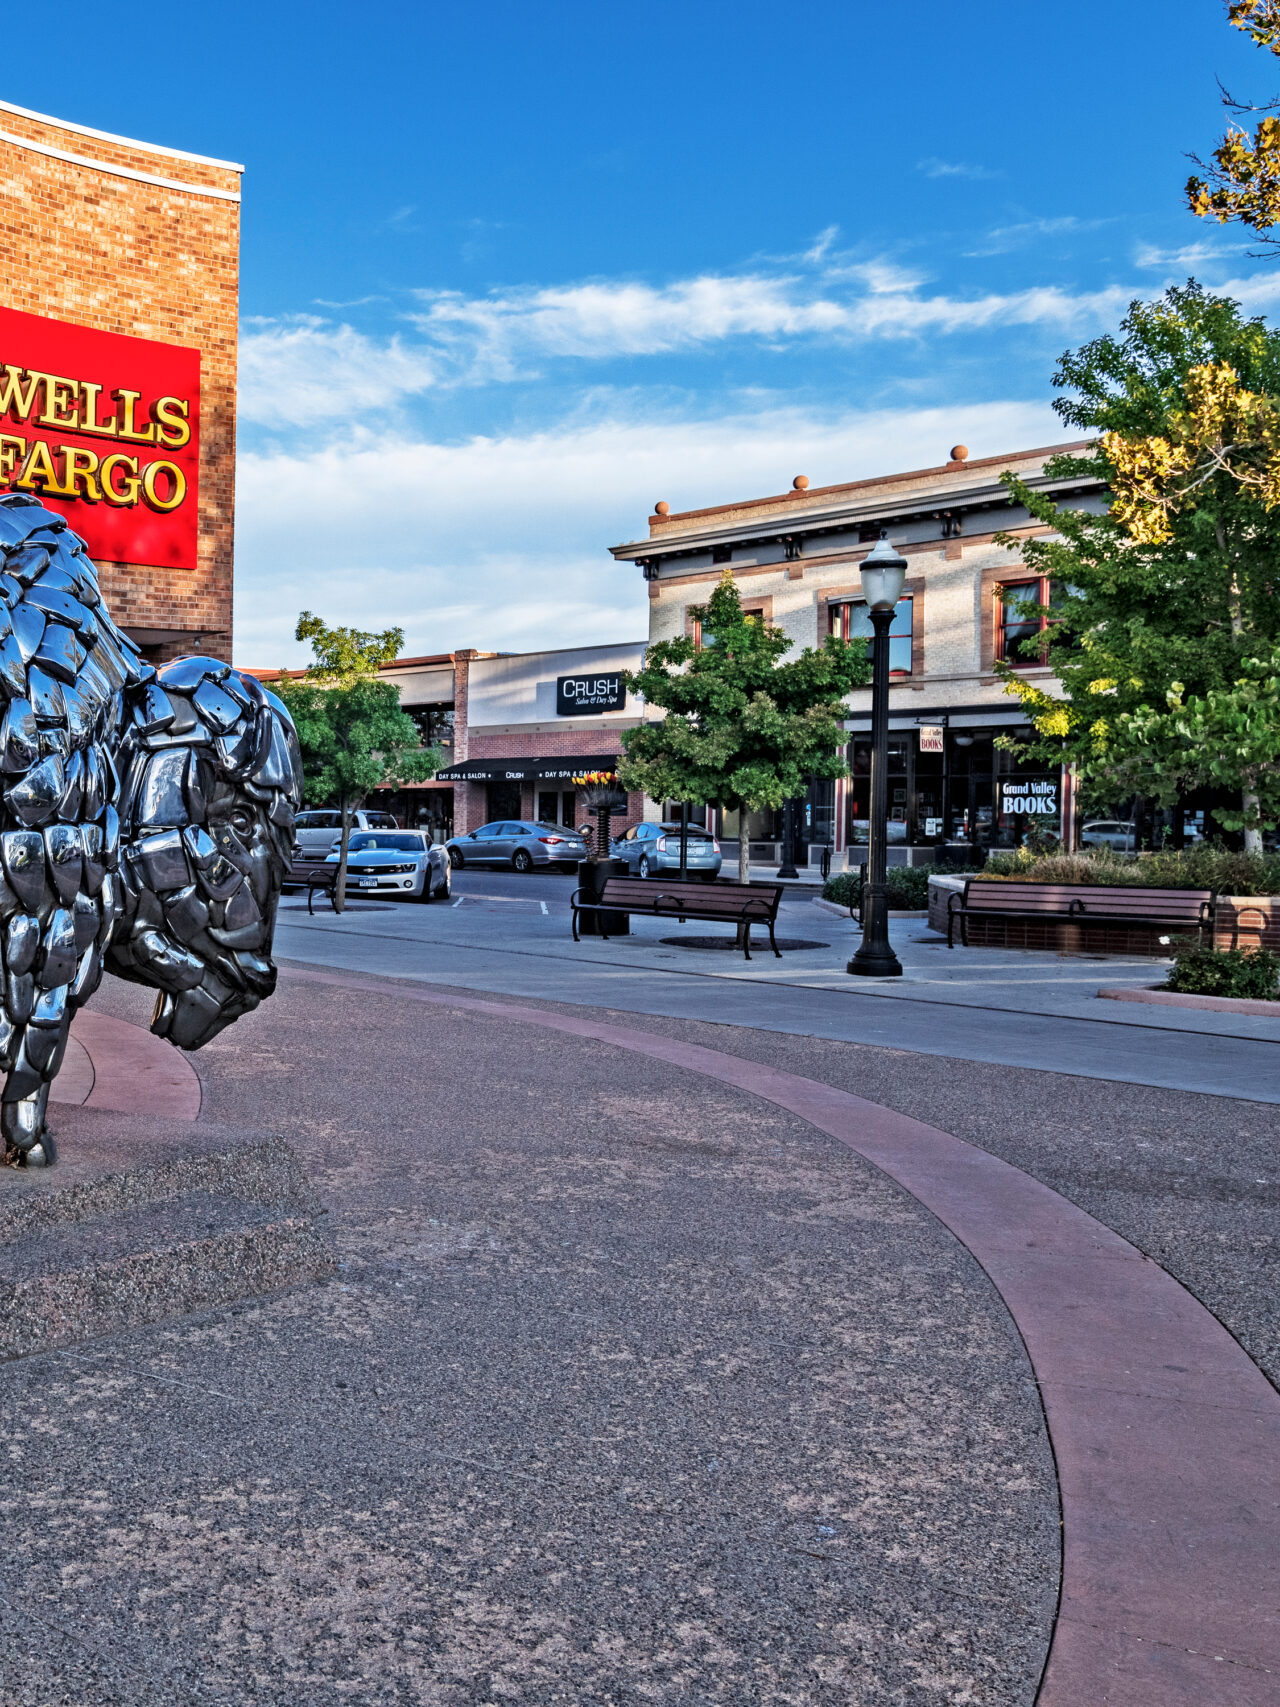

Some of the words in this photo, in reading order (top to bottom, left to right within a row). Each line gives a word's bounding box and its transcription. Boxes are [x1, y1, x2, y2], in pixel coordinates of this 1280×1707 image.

[563, 679, 618, 697] CRUSH
[922, 739, 942, 749] BOOKS
[1003, 782, 1028, 795] Grand
[1031, 782, 1056, 797] Valley
[1003, 797, 1056, 814] BOOKS
